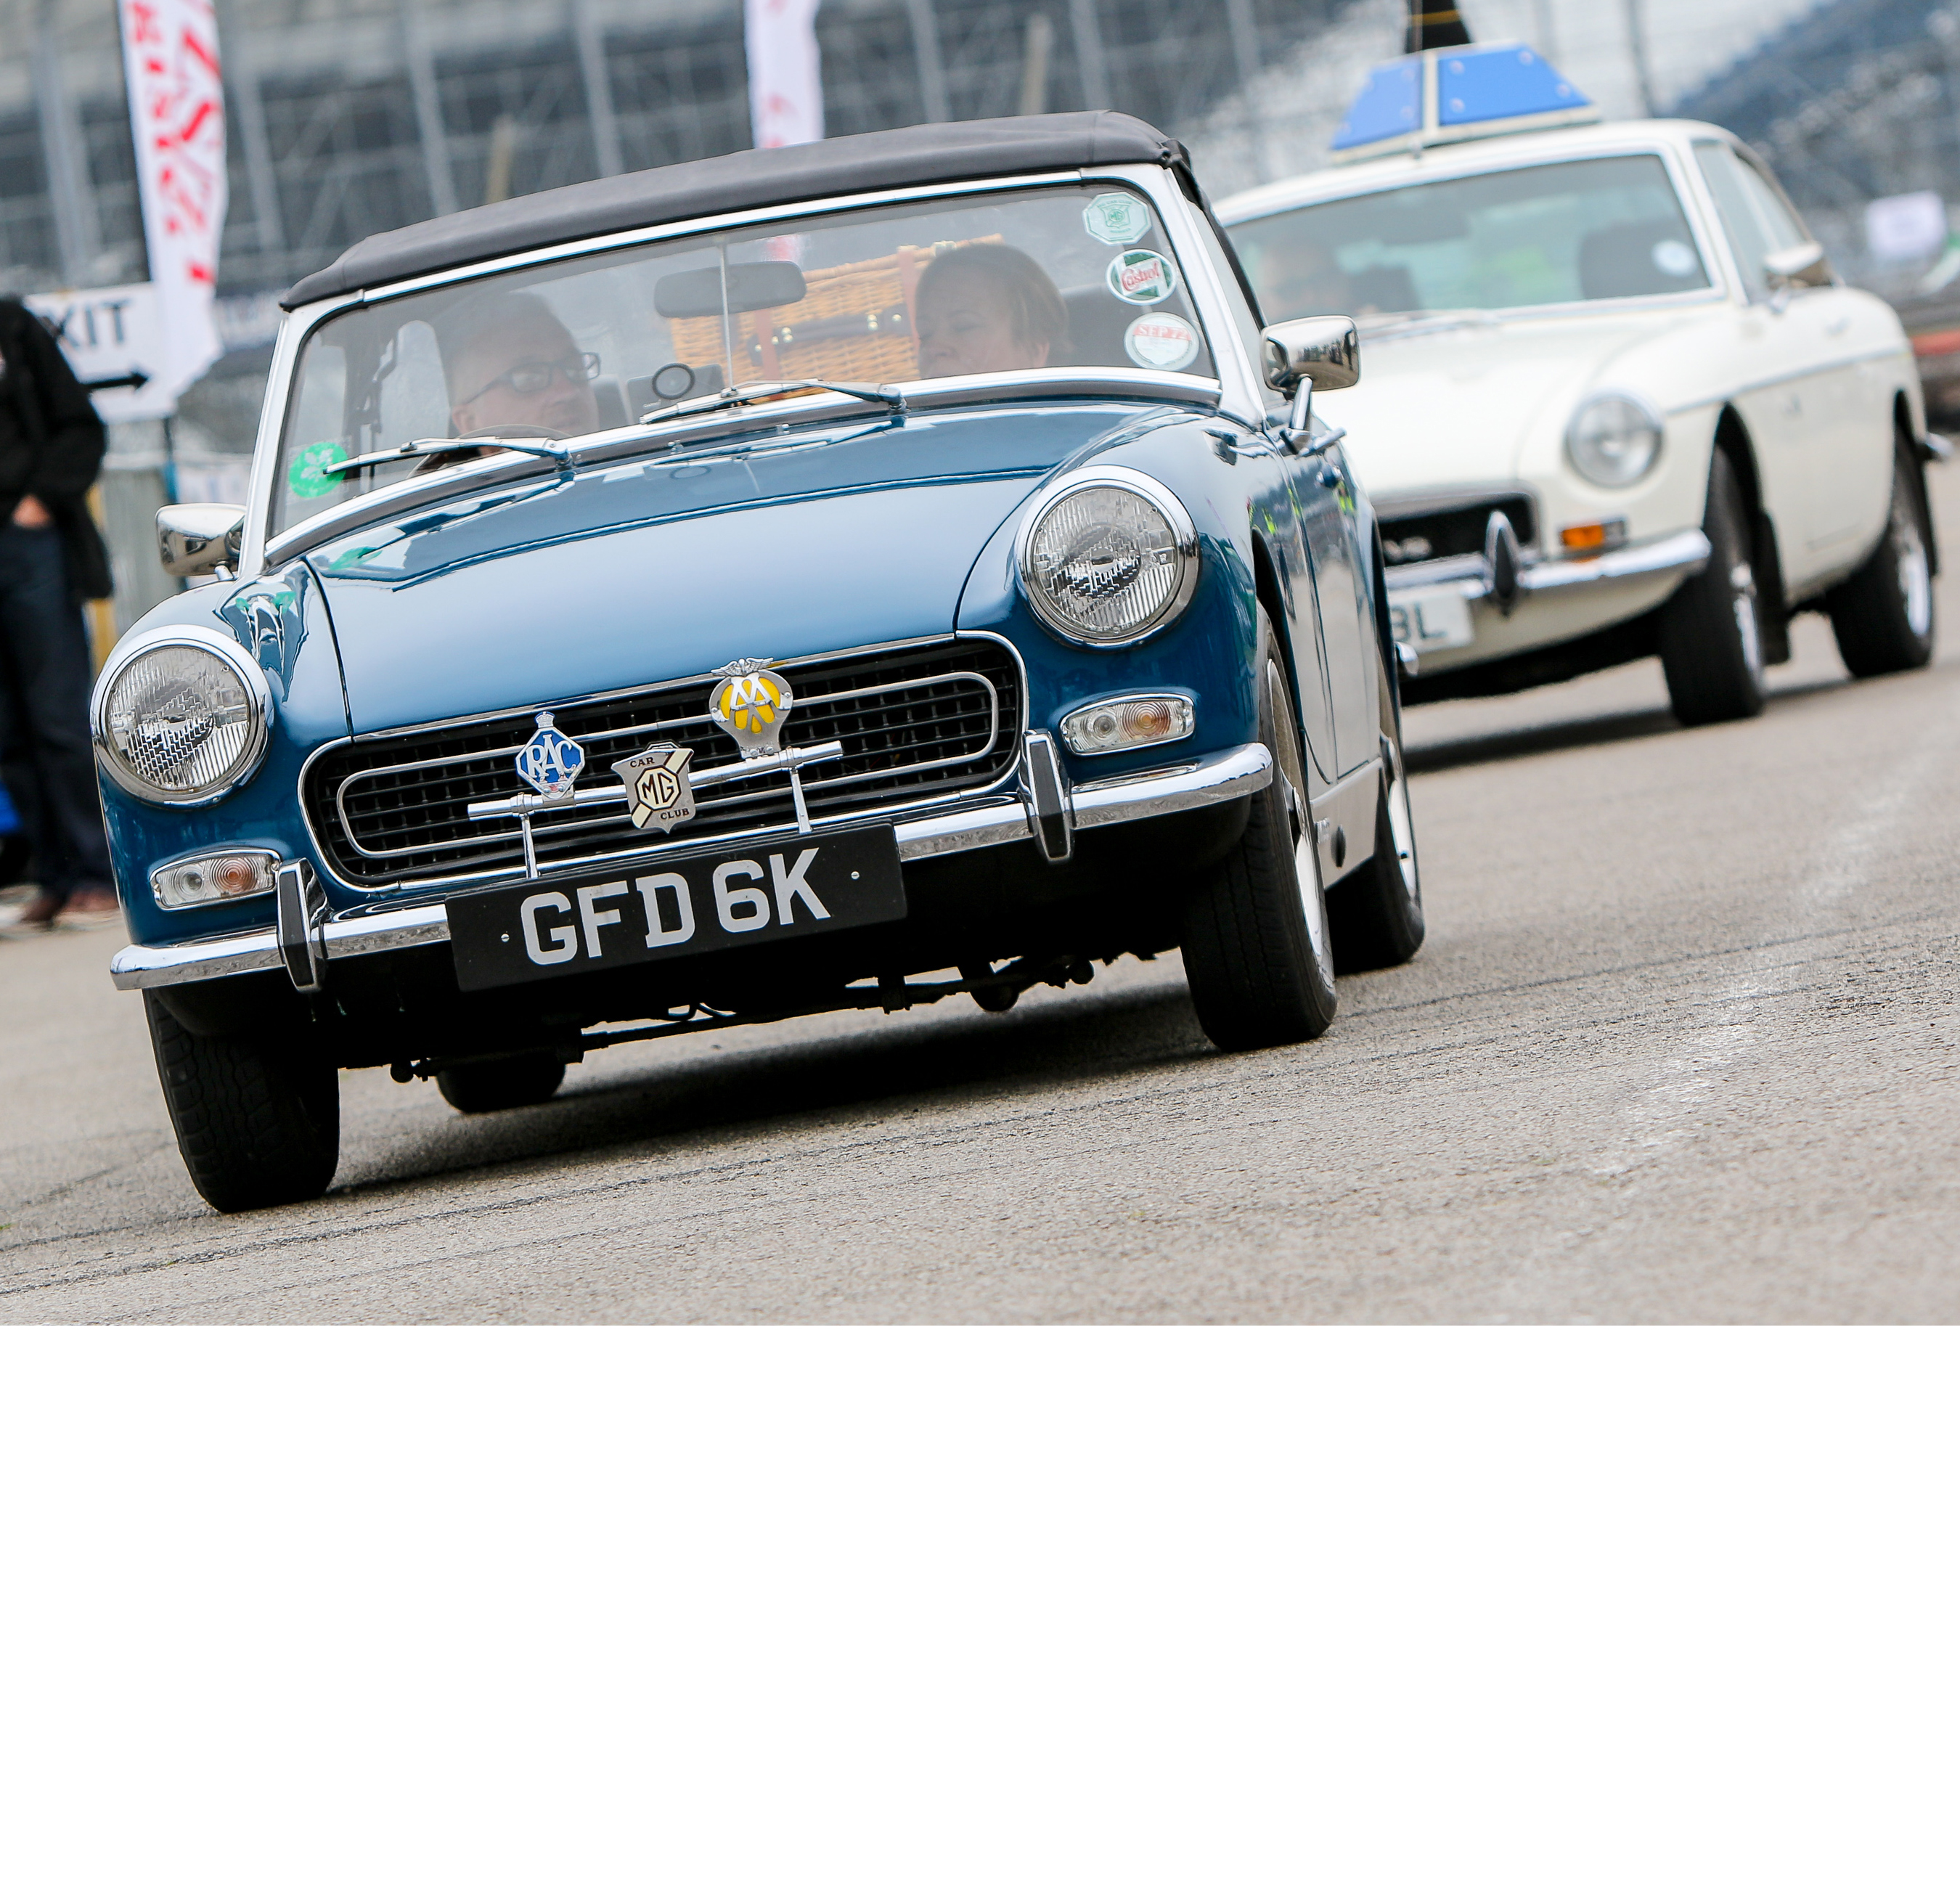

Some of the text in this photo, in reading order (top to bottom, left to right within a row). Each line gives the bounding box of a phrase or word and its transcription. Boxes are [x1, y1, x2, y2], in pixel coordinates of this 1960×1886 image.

[1121, 259, 1159, 292] Castrol
[45, 298, 133, 348] XIT
[1138, 324, 1168, 338] SEP
[728, 671, 777, 719] AA
[526, 734, 577, 784] RAC
[629, 756, 655, 768] CAR
[641, 772, 675, 805] MG
[660, 808, 690, 820] CLUB
[520, 846, 832, 966] GFD 6K
